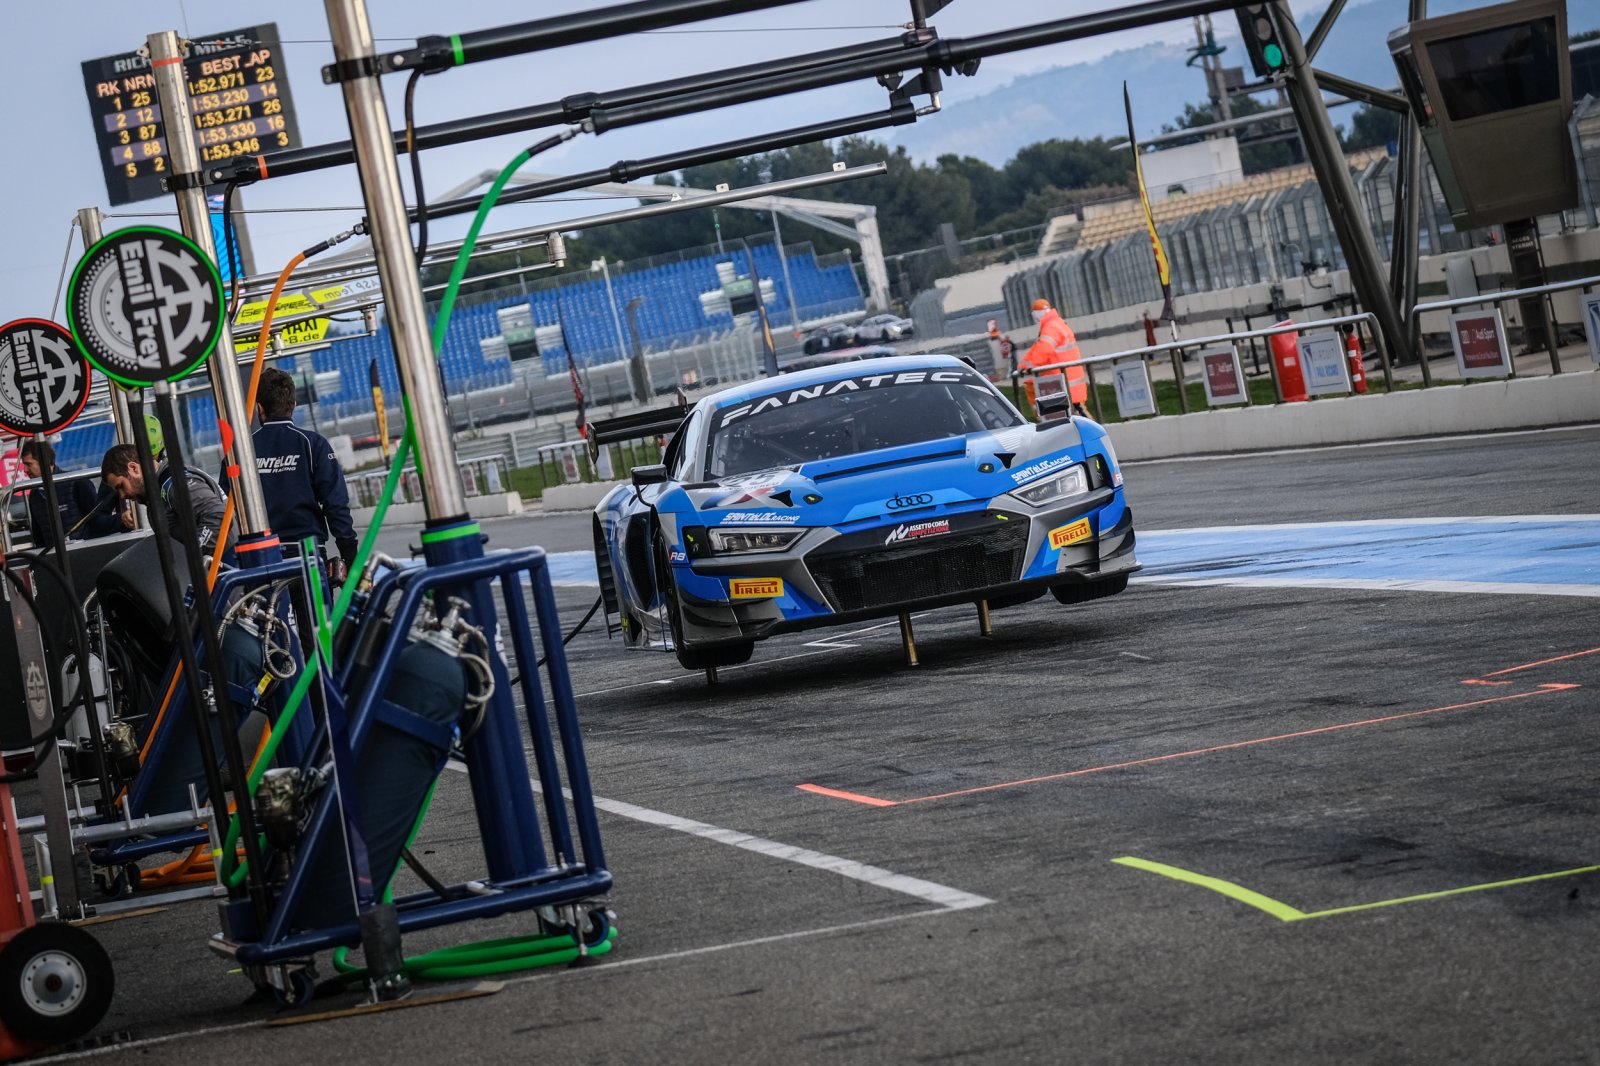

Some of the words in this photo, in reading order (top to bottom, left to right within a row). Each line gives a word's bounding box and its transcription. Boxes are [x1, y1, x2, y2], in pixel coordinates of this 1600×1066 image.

[96, 81, 121, 98] RK
[202, 55, 241, 76] BEST
[112, 97, 122, 111] 1
[132, 91, 151, 107] 25
[256, 66, 275, 83] 23
[116, 113, 127, 129] 2
[136, 108, 154, 124] 12
[260, 82, 278, 98] 14
[120, 130, 131, 144] 3
[139, 124, 157, 141] 87
[263, 99, 281, 115] 26
[123, 146, 134, 161] 4
[143, 141, 162, 157] 88
[267, 115, 285, 131] 16
[126, 162, 138, 178] 5
[154, 157, 165, 172] 2
[277, 132, 289, 147] 3
[119, 240, 157, 305] Emil
[12, 330, 39, 377] Emil
[132, 307, 162, 369] Frey
[22, 379, 43, 425] Frey
[720, 371, 963, 428] FANATEC
[908, 526, 950, 537] COMPETIZIONE
[910, 523, 932, 532] ASSETTO
[932, 520, 949, 528] CORSA
[1053, 522, 1089, 545] PIRELLI
[670, 551, 686, 561] R8
[734, 581, 778, 595] PIRELLI
